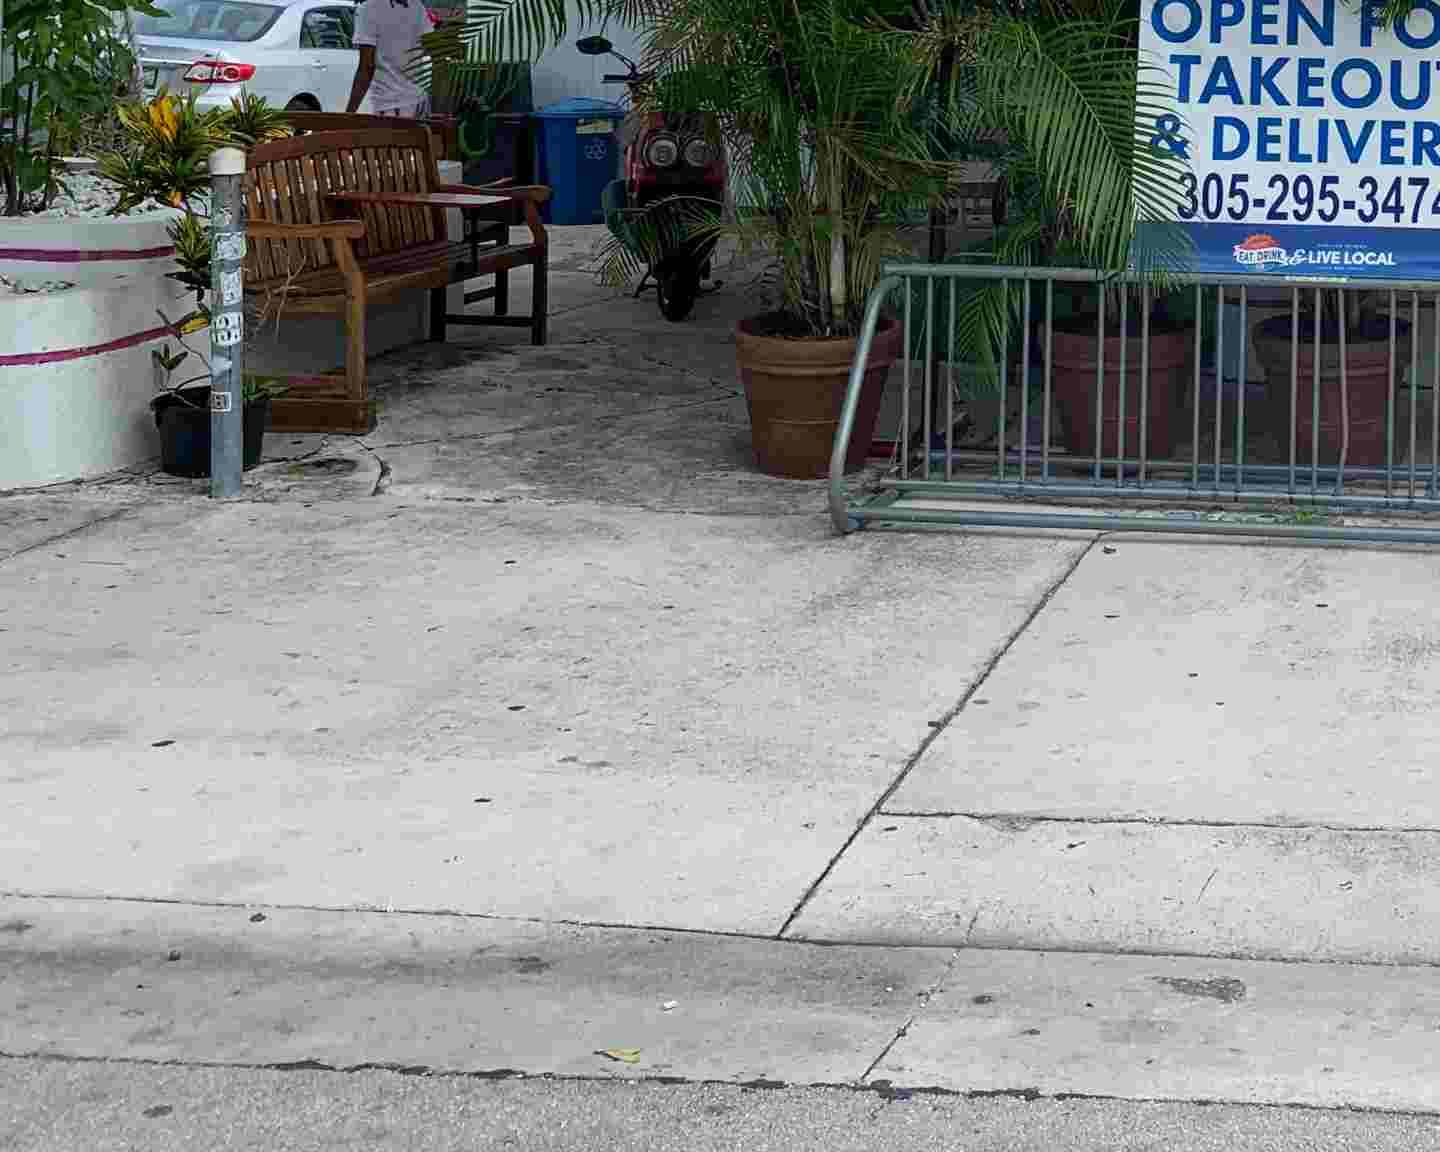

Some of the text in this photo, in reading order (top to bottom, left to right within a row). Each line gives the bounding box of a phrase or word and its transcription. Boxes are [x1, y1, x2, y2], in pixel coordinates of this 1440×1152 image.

[1151, 113, 1191, 159] &
[1308, 250, 1342, 265] LIVE
[1343, 251, 1397, 266] LOCAL
